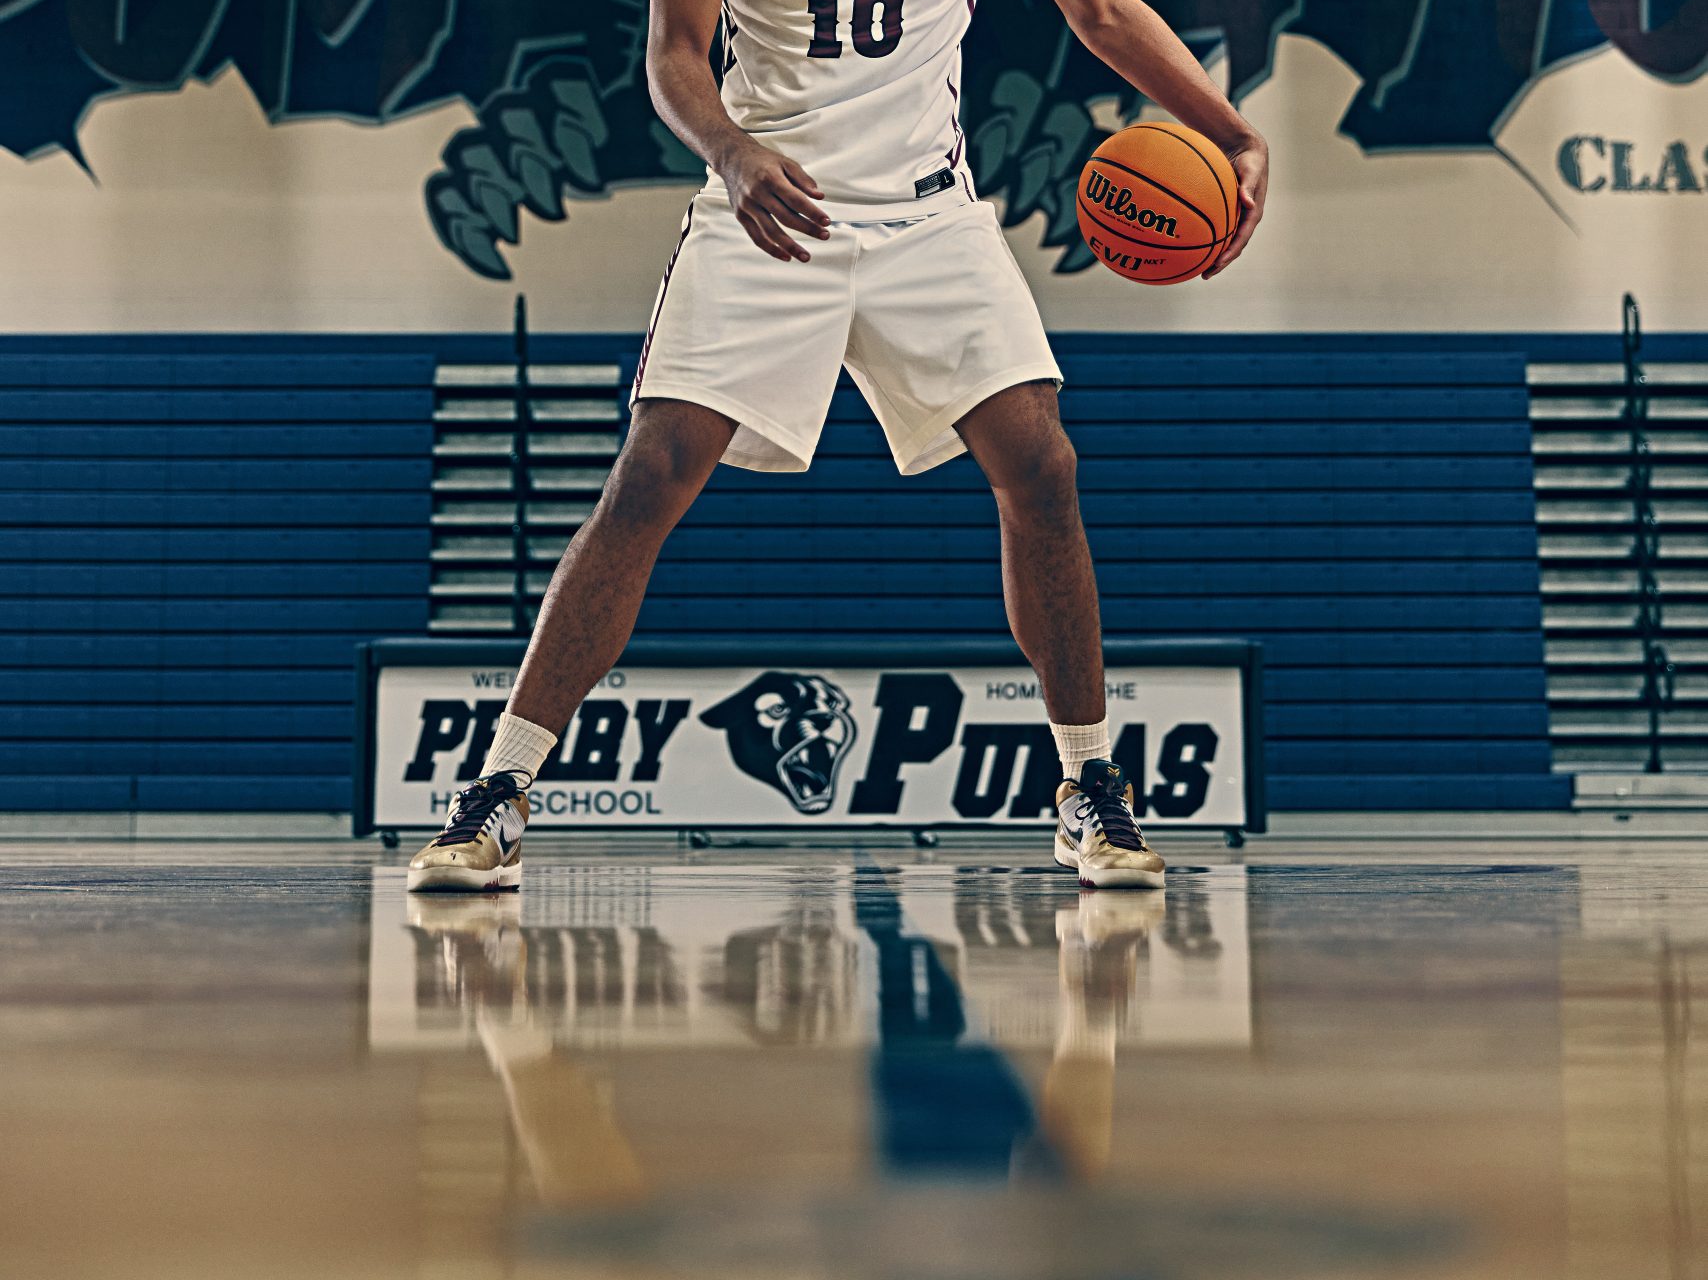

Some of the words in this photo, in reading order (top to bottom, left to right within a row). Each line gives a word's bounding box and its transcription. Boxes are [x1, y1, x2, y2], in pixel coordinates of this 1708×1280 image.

[1557, 134, 1708, 194] CLA
[1086, 169, 1177, 239] Wilson
[986, 682, 1044, 701] HOM
[1105, 682, 1138, 701] HE
[528, 790, 661, 815] SCHOOL
